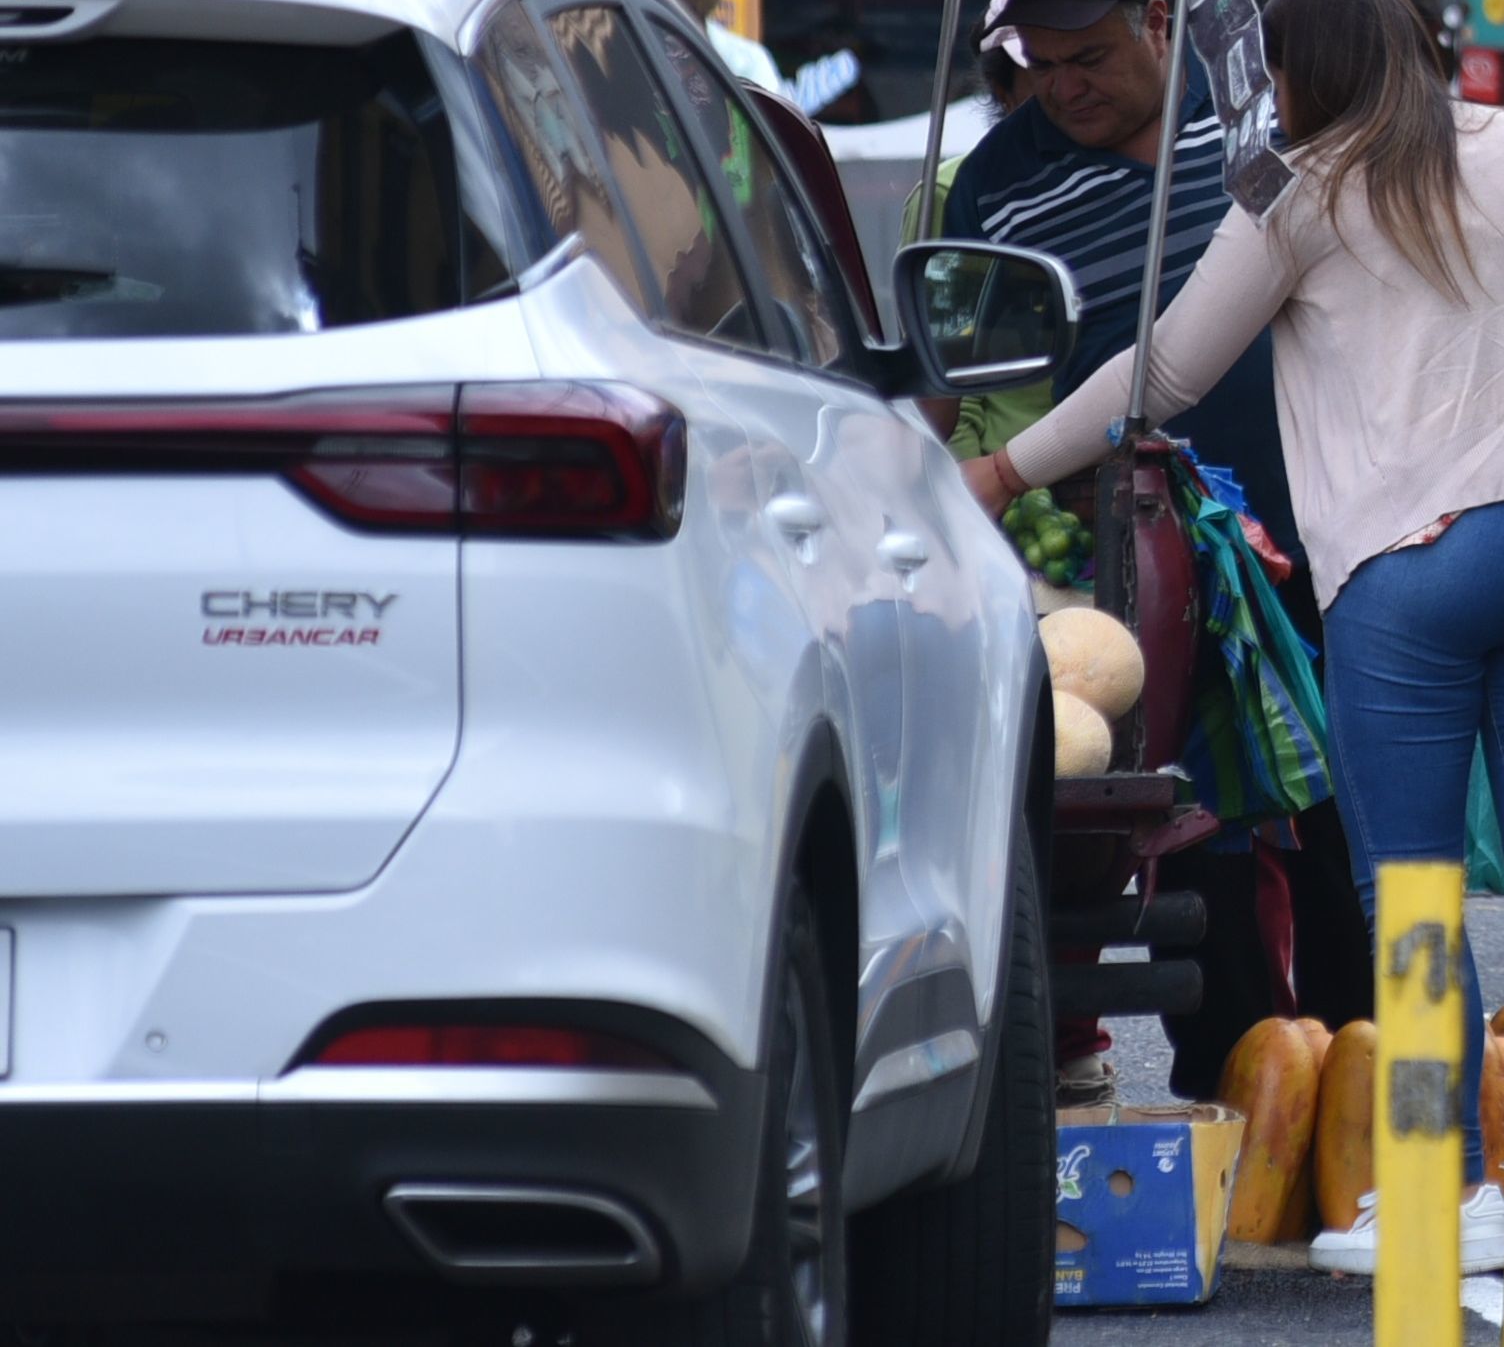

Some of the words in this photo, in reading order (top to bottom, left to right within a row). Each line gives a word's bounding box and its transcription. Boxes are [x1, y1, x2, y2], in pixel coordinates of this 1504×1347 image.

[201, 590, 399, 619] CHERY
[202, 627, 380, 646] URBANCAR
[1055, 1269, 1084, 1282] BAN
[1055, 1282, 1081, 1294] PRE
